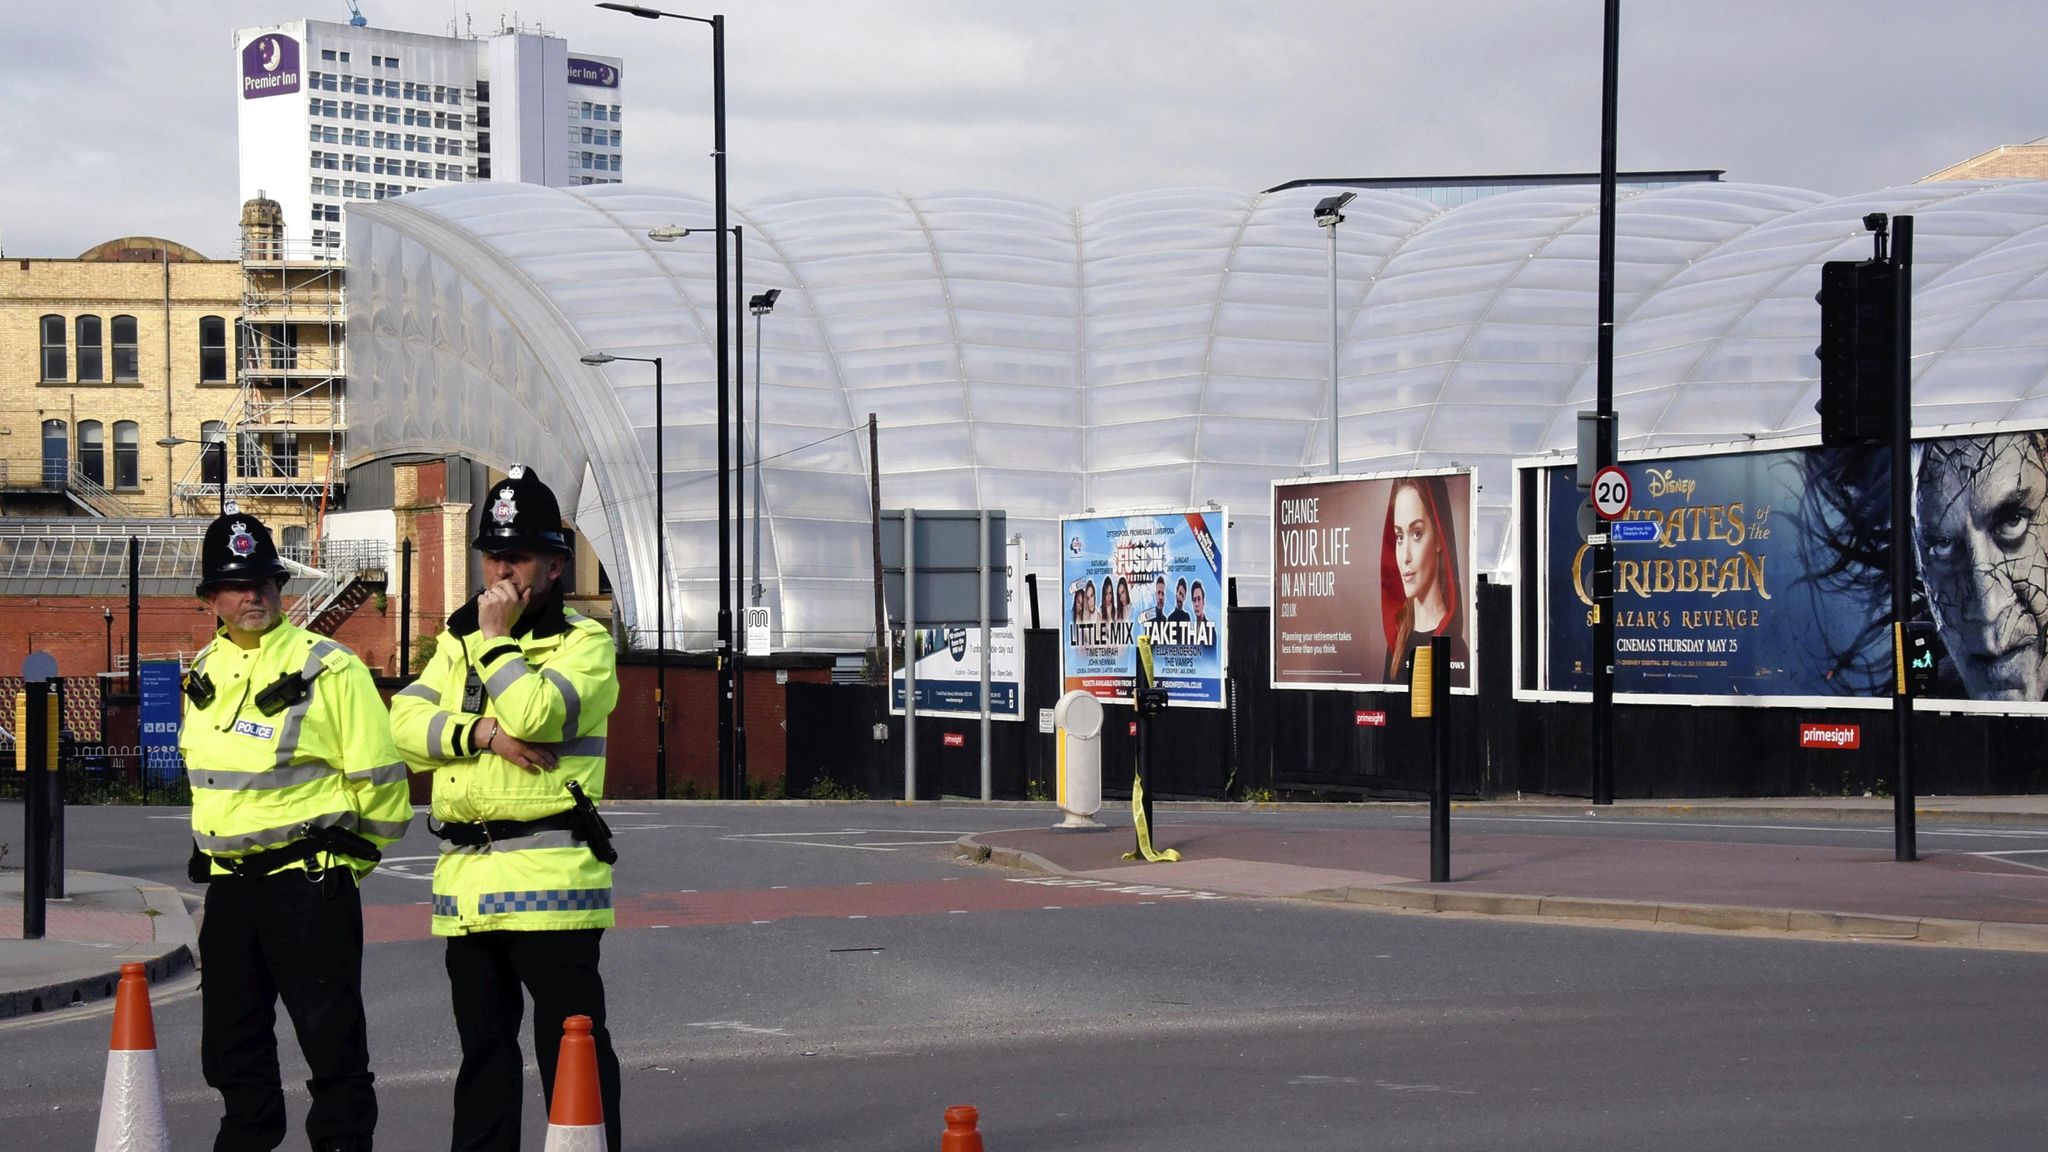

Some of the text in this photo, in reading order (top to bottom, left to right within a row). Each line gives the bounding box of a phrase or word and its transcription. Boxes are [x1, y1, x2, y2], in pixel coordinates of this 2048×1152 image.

[244, 72, 297, 91] Premier Inn
[584, 67, 597, 80] Inn
[1598, 482, 1626, 504] 20
[1646, 468, 1695, 502] Disney
[1281, 498, 1319, 525] CHANGE
[1756, 504, 1771, 524] of
[1748, 522, 1770, 540] the
[1281, 527, 1351, 567] YOUR LIFE
[1117, 546, 1163, 573] FUSION
[1281, 571, 1335, 597] IN AN HOUR
[1571, 543, 1771, 606] CRIBBEAN
[1586, 608, 1760, 630] SAZAR'S REVENGE
[1070, 622, 1134, 647] LITTLE MIX
[1144, 621, 1215, 646] TAKE THAT
[1281, 631, 1352, 643] Planning your retirement takes
[1156, 647, 1202, 656] ELLA HENDERSON
[1281, 643, 1291, 653] less
[1291, 643, 1302, 653] time
[1313, 646, 1322, 655] you
[1616, 638, 1738, 653] CINEMAS THURSDAY MAY 25
[1164, 657, 1193, 667] THE VAMPS
[1357, 712, 1383, 725] primesight
[237, 721, 272, 738] POLICE
[1803, 727, 1854, 746] primesight
